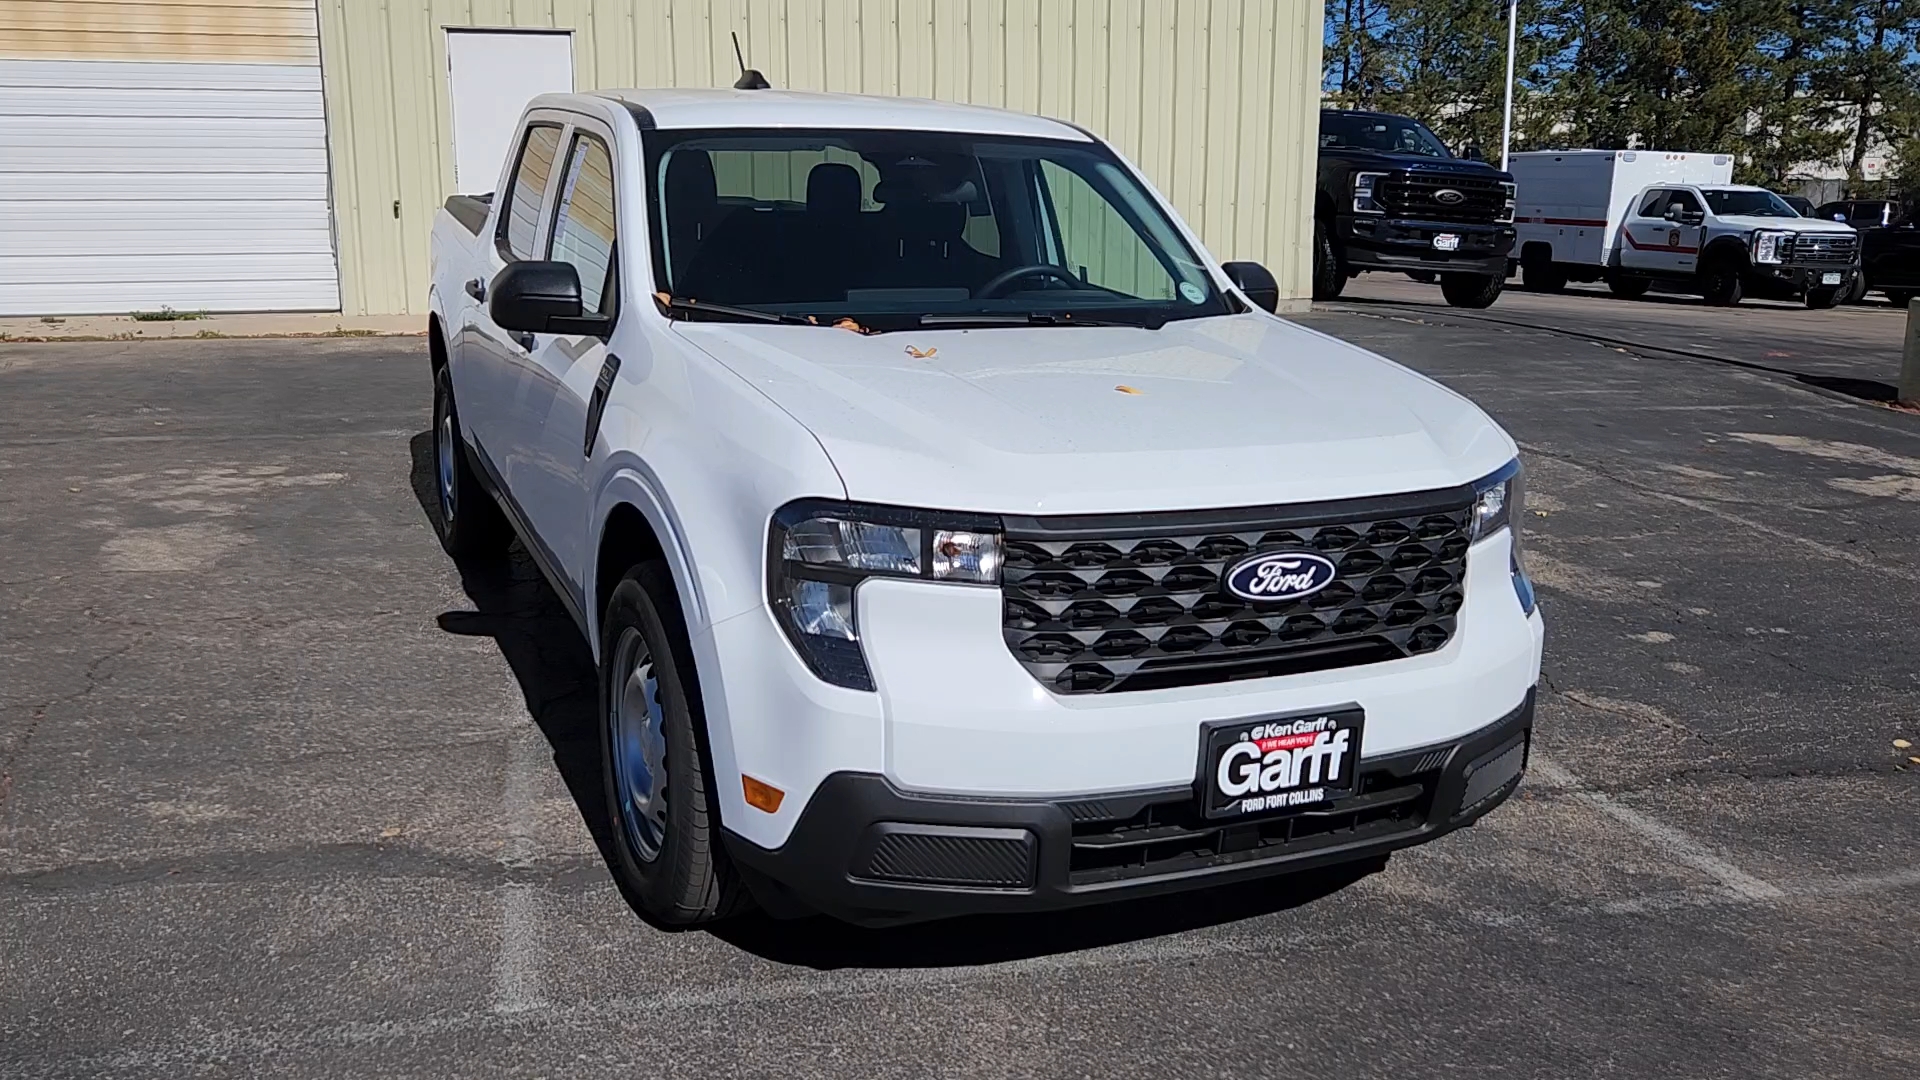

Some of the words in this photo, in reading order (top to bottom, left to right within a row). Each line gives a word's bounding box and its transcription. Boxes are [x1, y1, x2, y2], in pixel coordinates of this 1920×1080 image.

[1433, 236, 1459, 248] Garff
[1249, 560, 1317, 594] Ford
[1264, 723, 1292, 739] Ken
[1293, 717, 1328, 735] Garff
[1267, 740, 1278, 749] WE
[1278, 738, 1296, 747] HEAR
[1217, 729, 1349, 796] Garff
[1242, 797, 1265, 813] FORD
[1266, 793, 1288, 809] FORT
[1289, 788, 1324, 805] COLLINS
